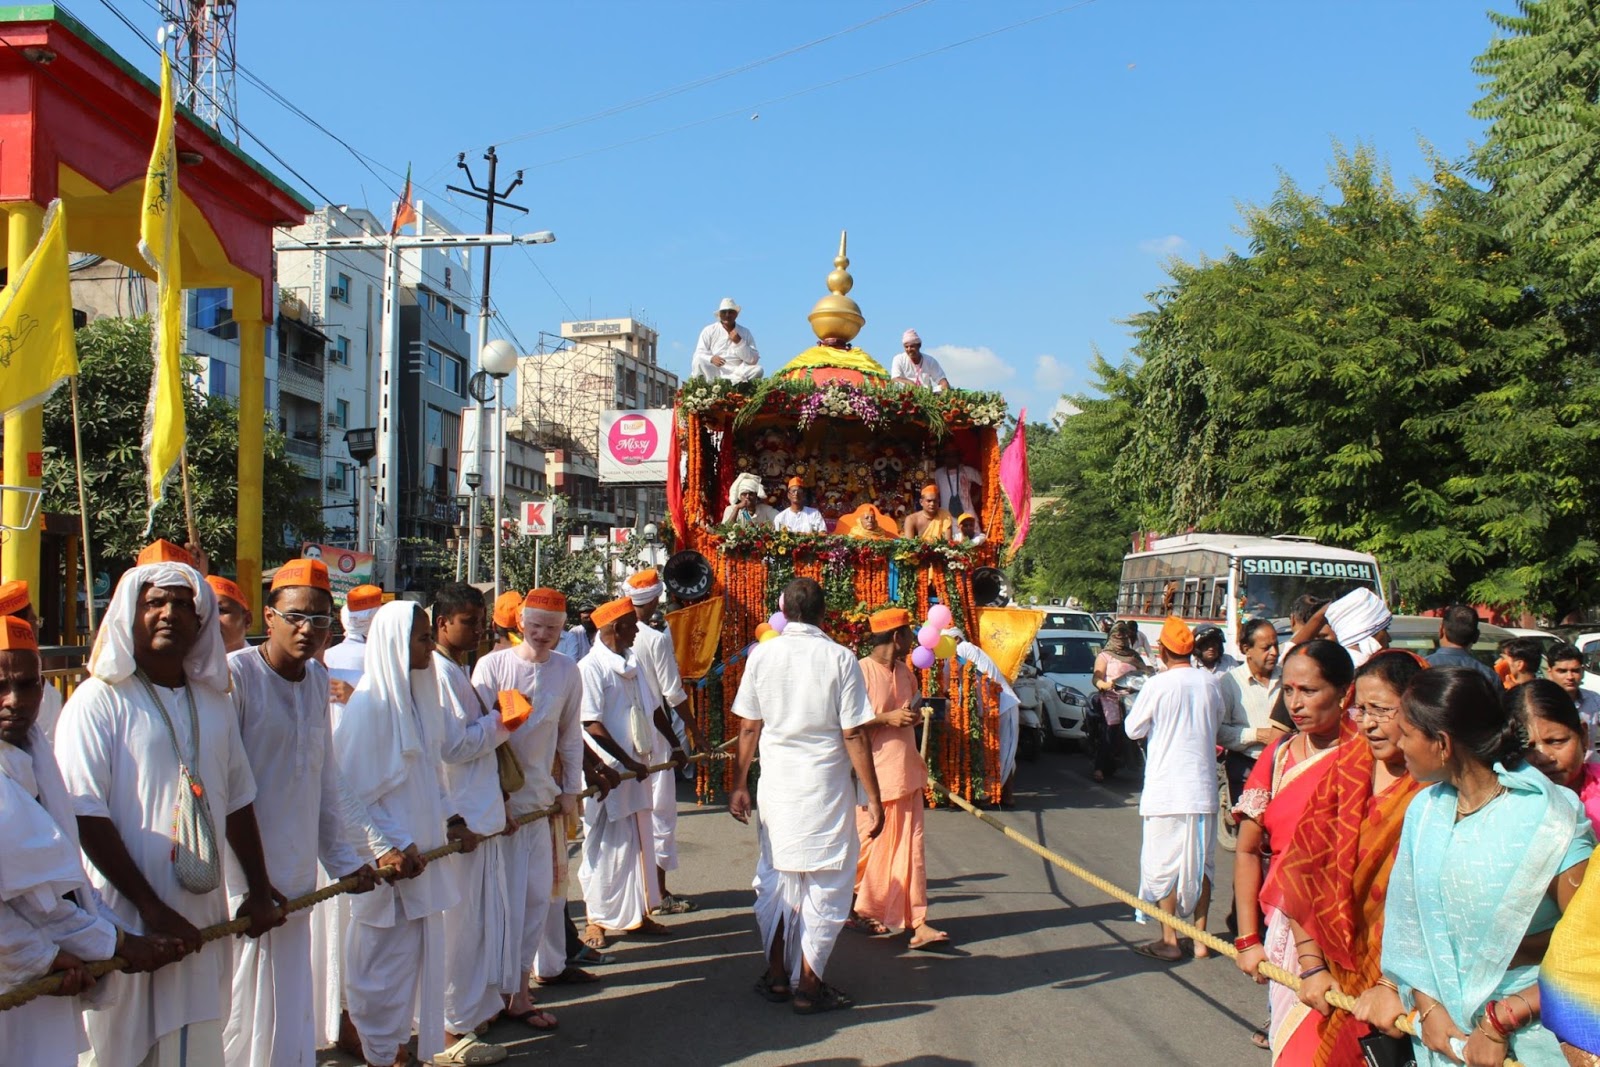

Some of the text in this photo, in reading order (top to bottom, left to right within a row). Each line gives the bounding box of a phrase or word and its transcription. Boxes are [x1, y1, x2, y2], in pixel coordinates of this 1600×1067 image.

[615, 437, 650, 454] Missy
[527, 503, 546, 525] K
[1243, 559, 1371, 579] SADAF COACH
